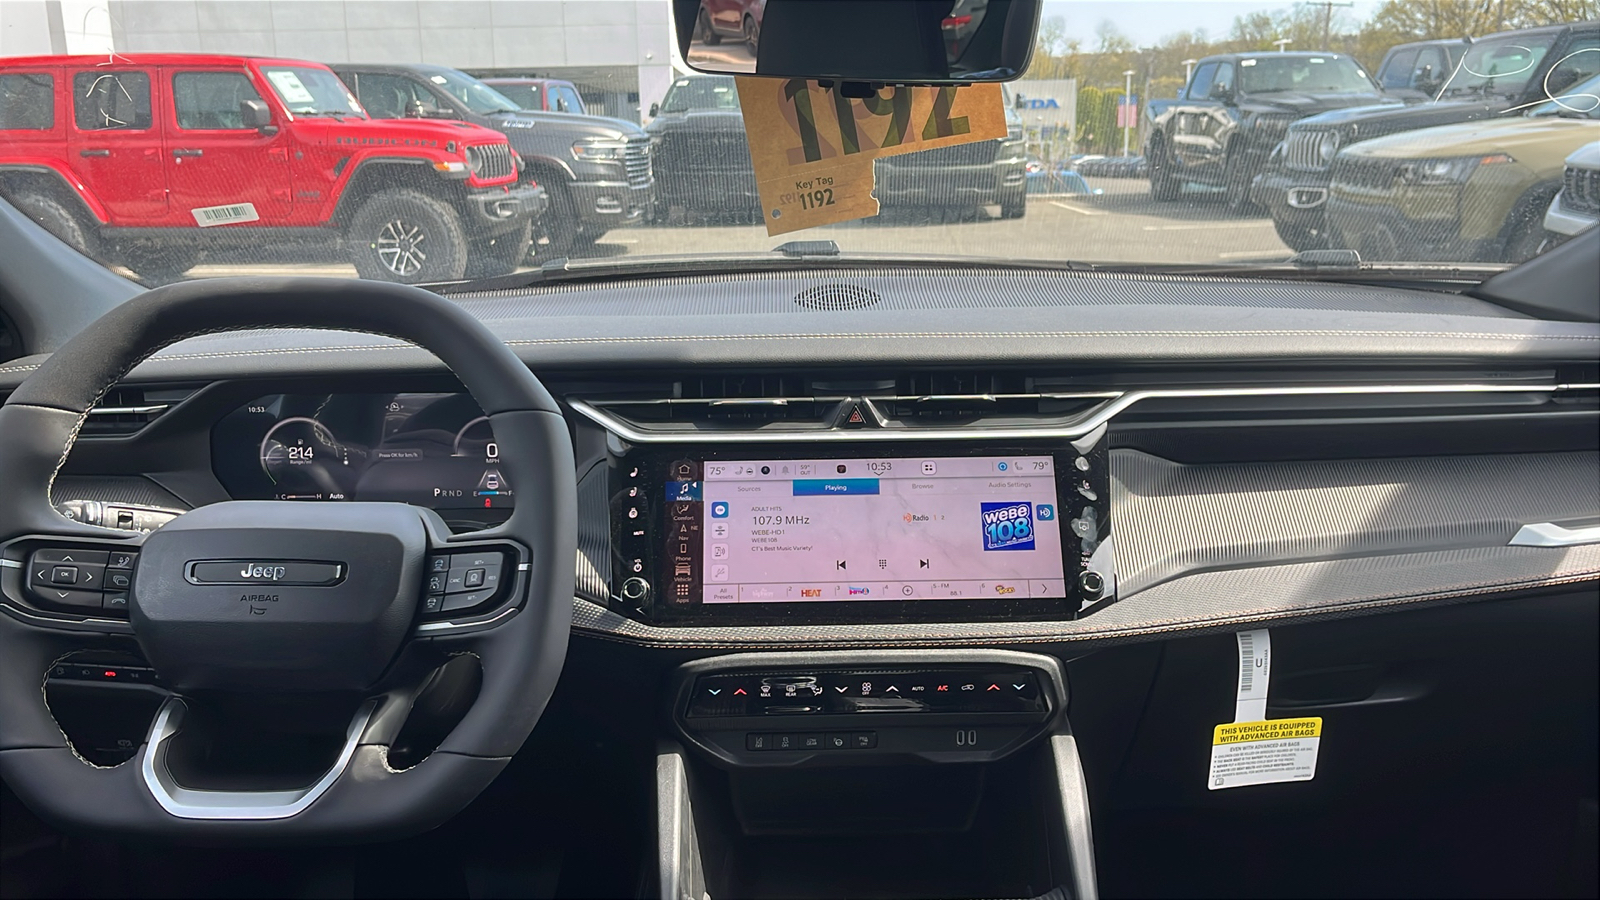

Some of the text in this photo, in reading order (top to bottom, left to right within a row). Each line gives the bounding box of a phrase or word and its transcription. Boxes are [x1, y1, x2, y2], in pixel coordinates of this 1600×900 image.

[796, 176, 834, 190] Key Tag
[800, 188, 835, 210] 1192
[288, 447, 313, 459] 214
[487, 443, 498, 458] 0
[710, 467, 726, 475] 75°
[866, 462, 892, 471] 10:53
[1032, 462, 1048, 470] 79°
[434, 488, 440, 496] P
[753, 516, 810, 525] 107.9 MHz
[988, 518, 1030, 543] 108
[240, 564, 285, 580] Jeep
[801, 589, 821, 597] HEAT
[1256, 659, 1262, 667] U
[1239, 725, 1268, 733] VEHICLE
[1279, 722, 1316, 730] EQUIPPED
[1240, 731, 1279, 741] ADVANCED
